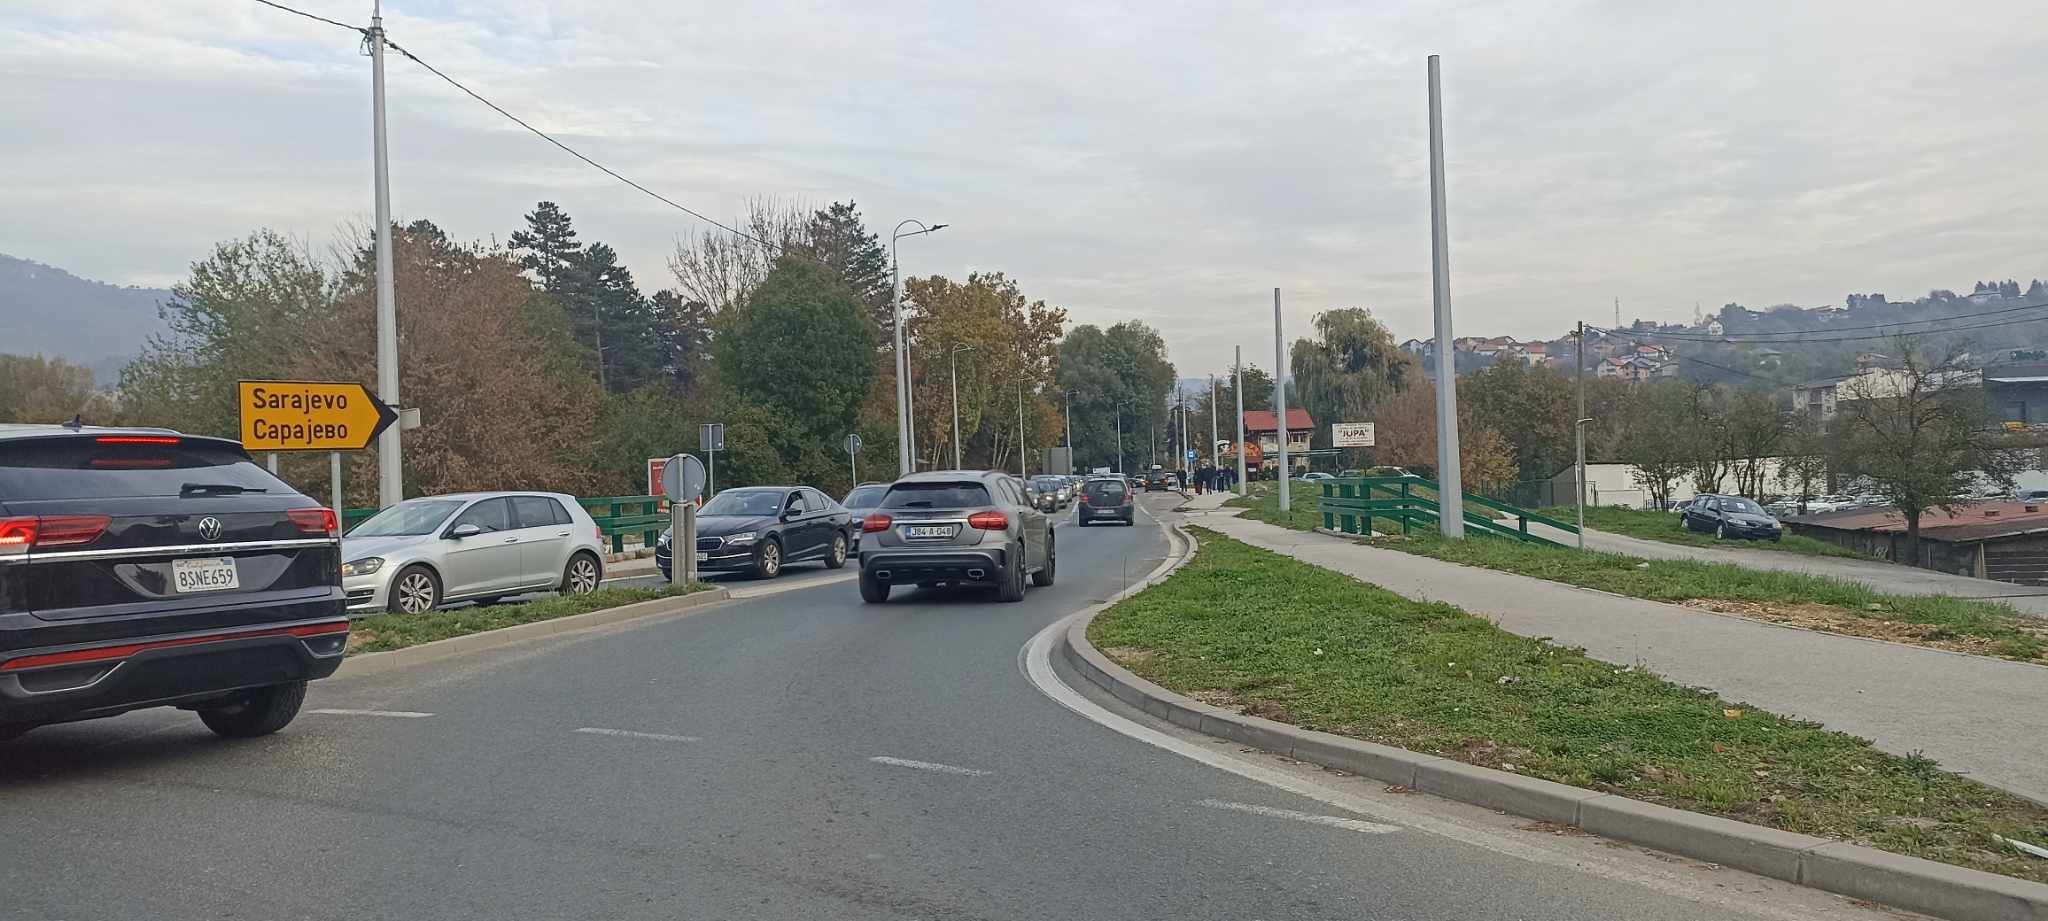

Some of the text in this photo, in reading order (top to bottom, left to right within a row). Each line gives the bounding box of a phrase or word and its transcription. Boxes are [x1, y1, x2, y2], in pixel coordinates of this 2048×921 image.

[253, 388, 347, 414] Sarajevo
[253, 419, 348, 444] Сарајево
[180, 568, 233, 587] 8SNE659
